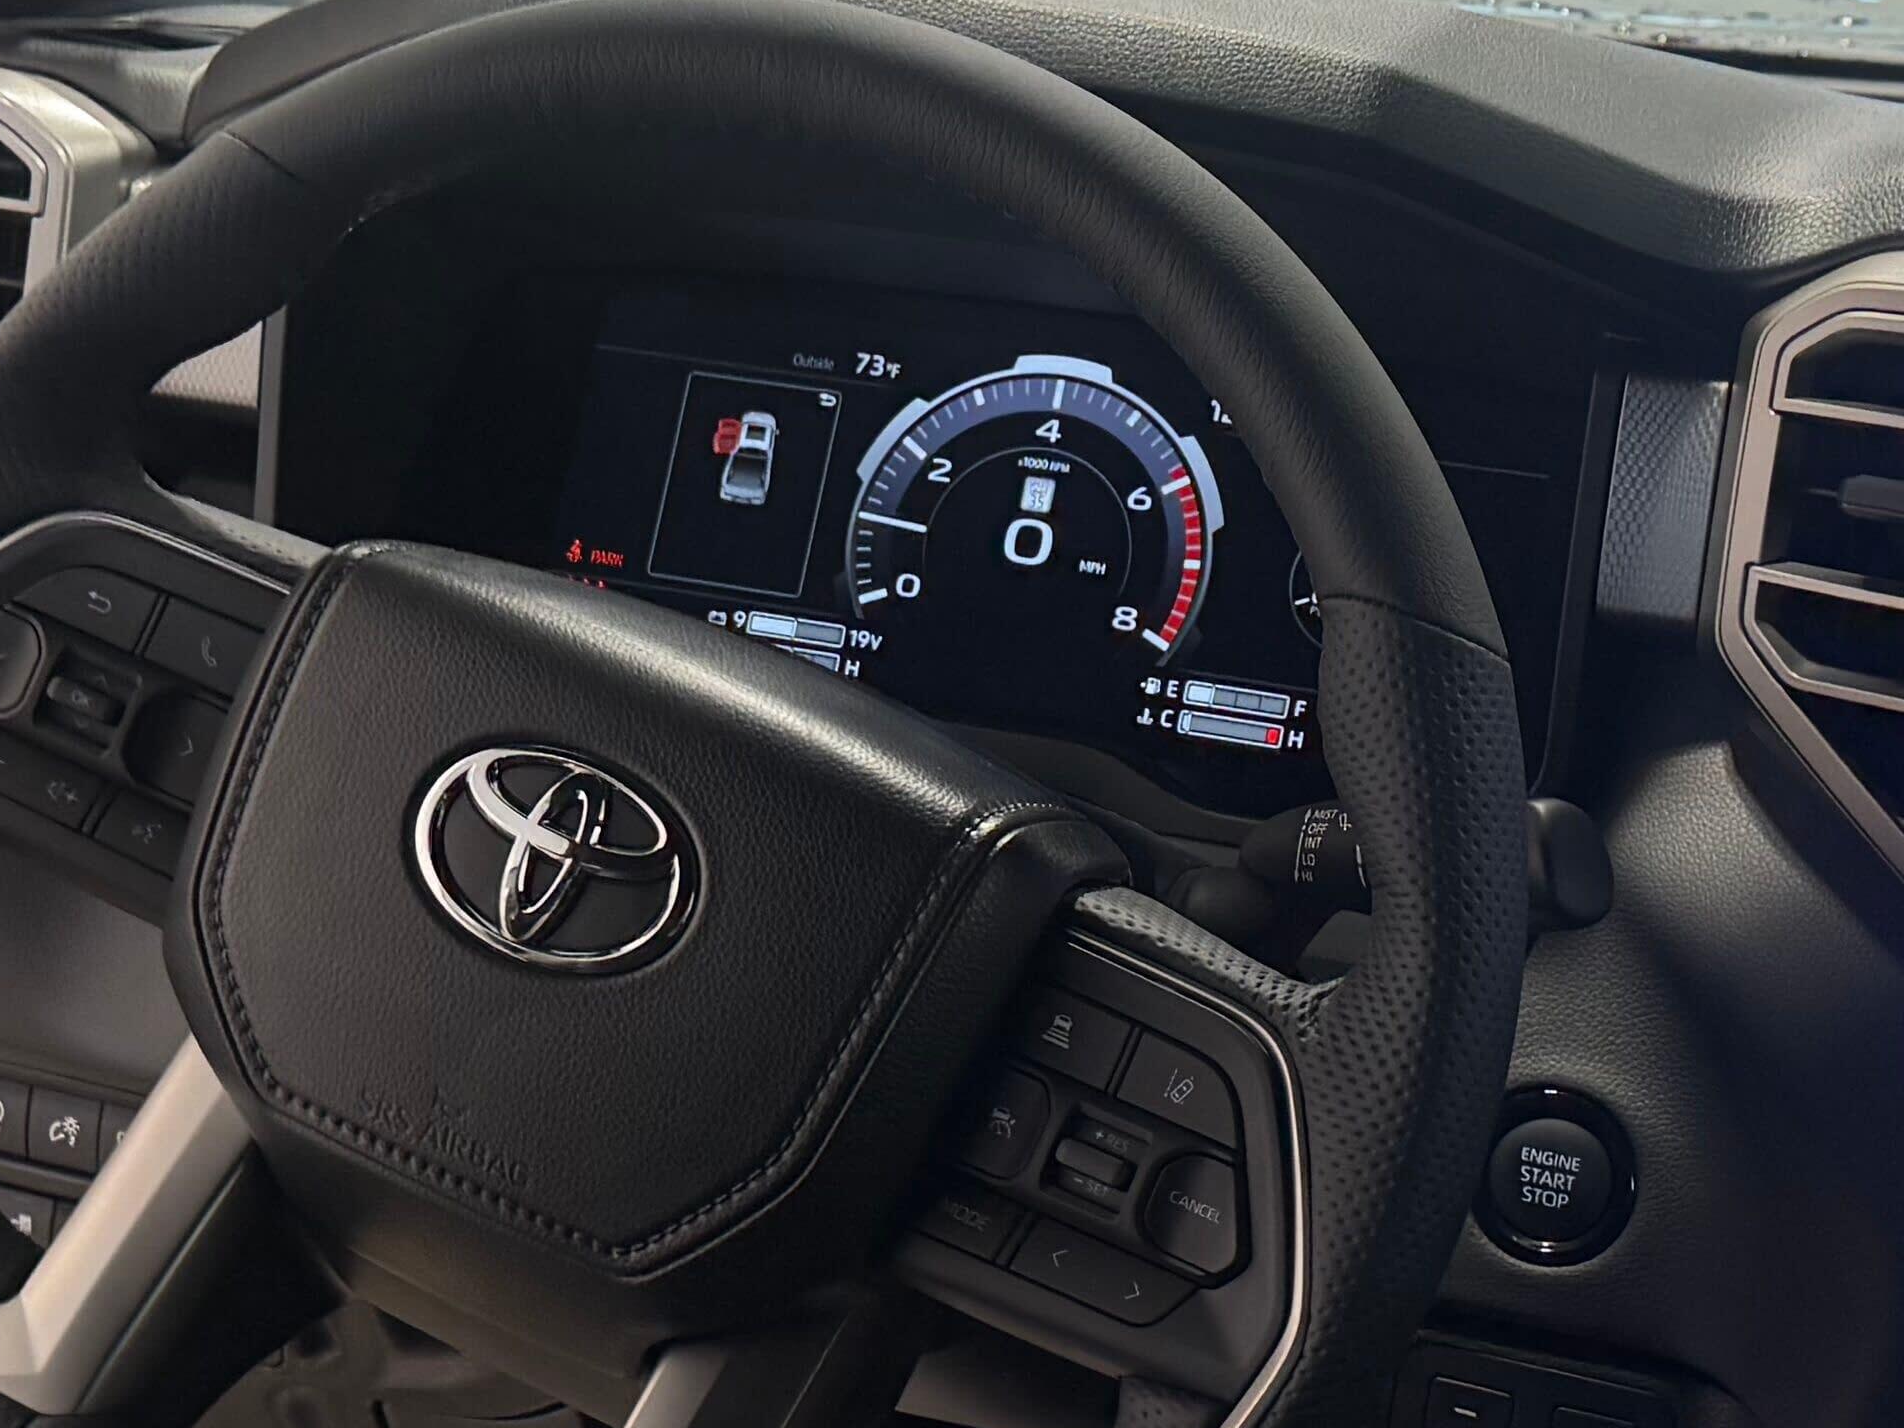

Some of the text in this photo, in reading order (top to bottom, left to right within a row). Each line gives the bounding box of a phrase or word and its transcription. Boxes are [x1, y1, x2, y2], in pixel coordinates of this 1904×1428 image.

[792, 353, 835, 371] Outside
[1035, 419, 1062, 444] 4
[927, 458, 954, 483] 2
[1127, 486, 1153, 512] 6
[1003, 518, 1054, 566] 0
[1079, 559, 1107, 575] MPH
[896, 573, 921, 599] 0
[732, 610, 884, 652] 9 19V
[1111, 606, 1138, 632] 8
[844, 659, 860, 678] H
[1167, 679, 1308, 718] E F
[1160, 709, 1305, 749] C H
[1307, 822, 1329, 835] OFF
[1304, 836, 1322, 849] INT
[1302, 852, 1316, 866] LO
[1521, 1146, 1582, 1172] ENGINE
[1520, 1165, 1576, 1191] START
[1169, 1190, 1222, 1224] CANCEL
[1521, 1186, 1569, 1208] STOP
